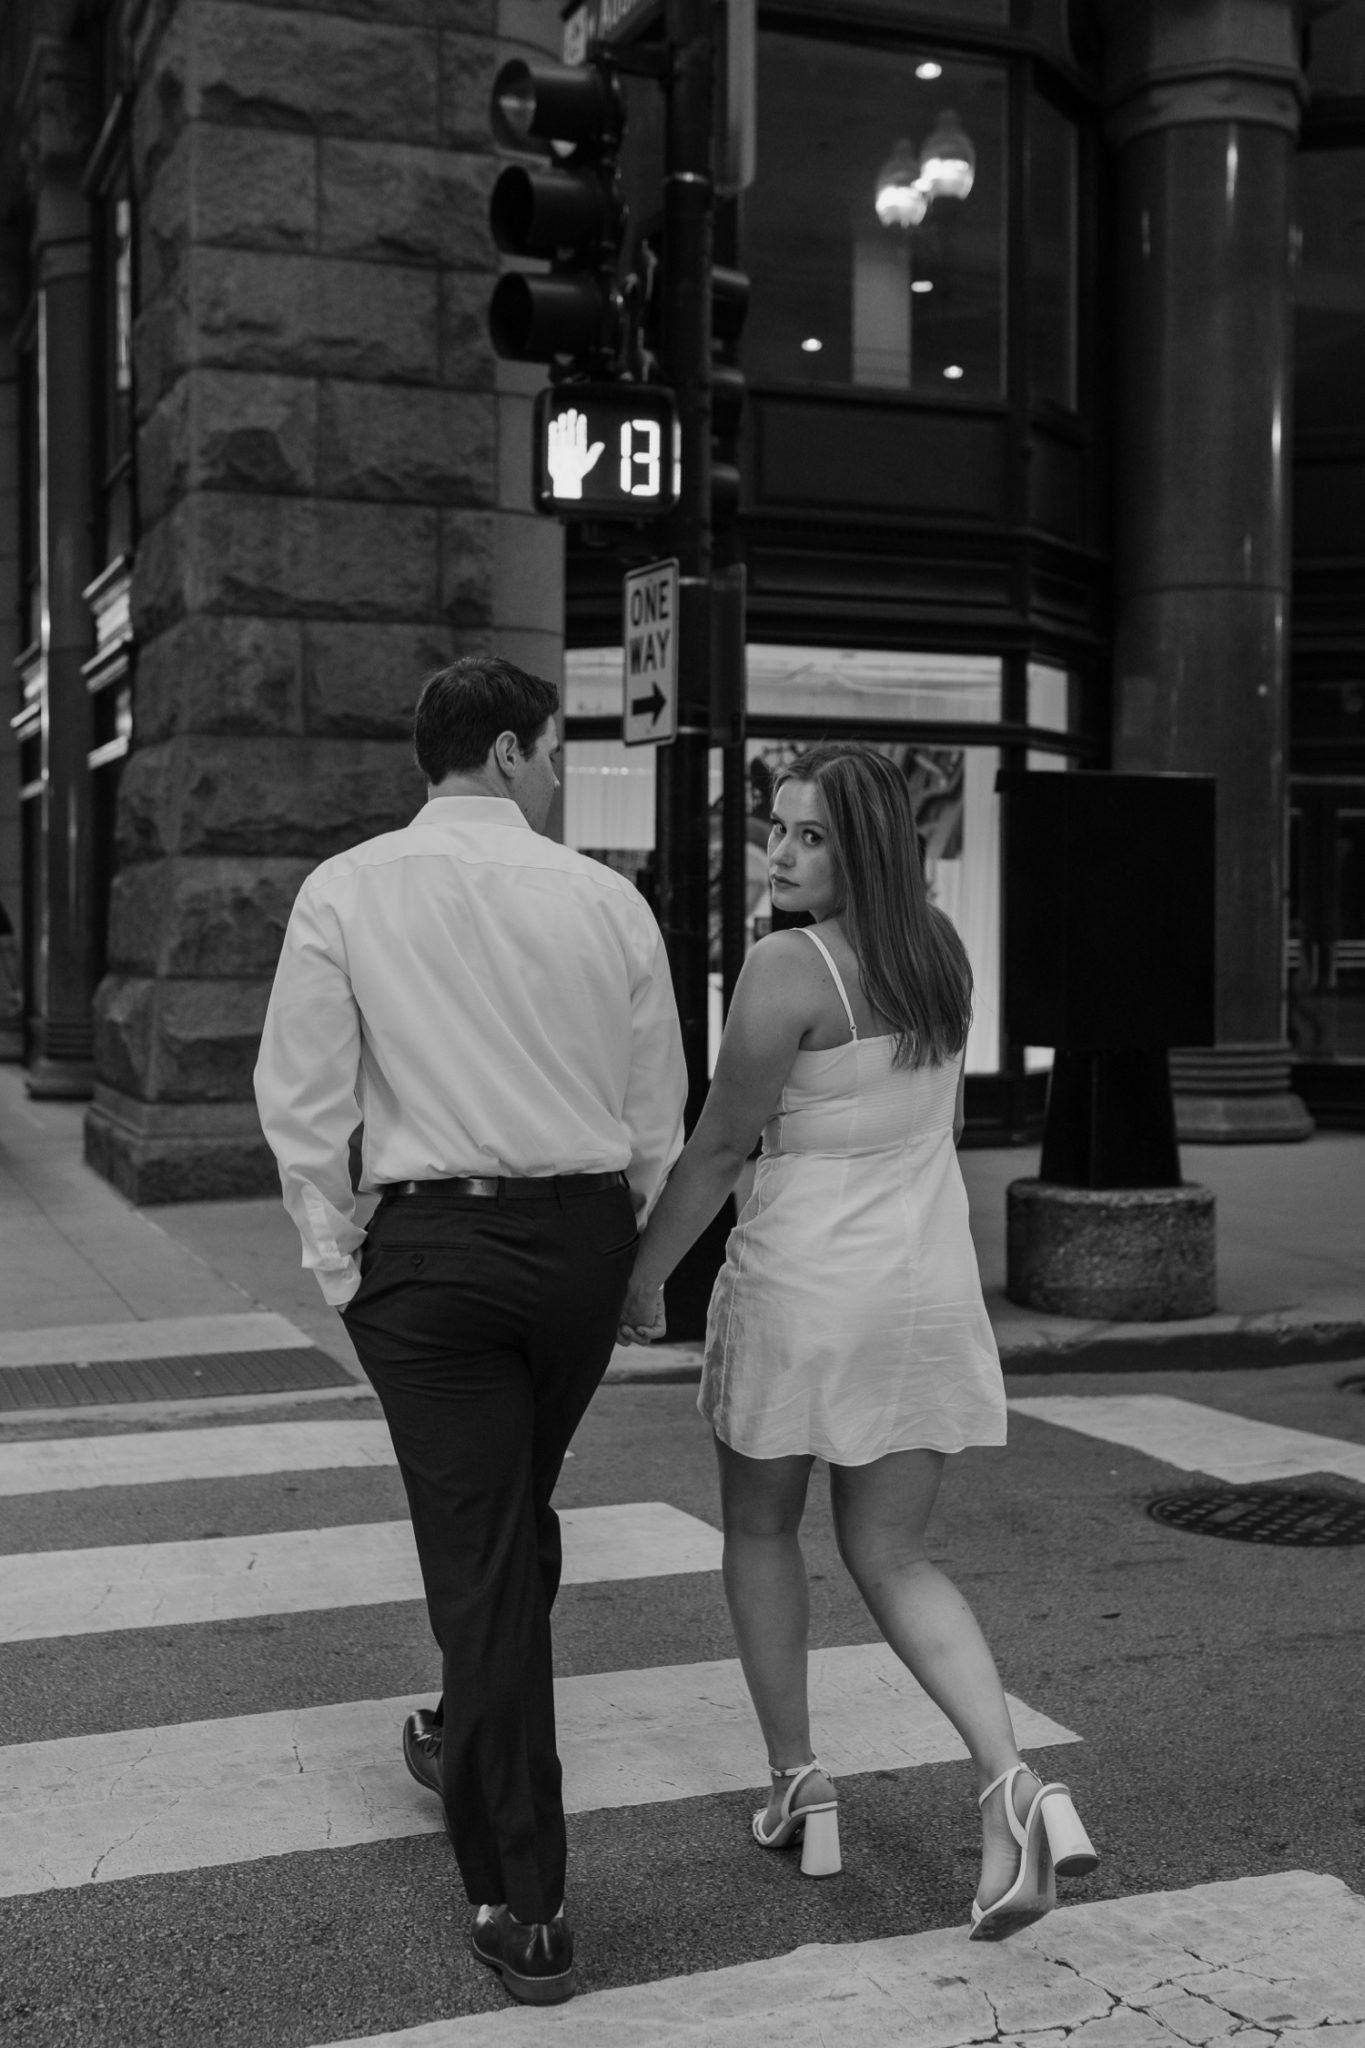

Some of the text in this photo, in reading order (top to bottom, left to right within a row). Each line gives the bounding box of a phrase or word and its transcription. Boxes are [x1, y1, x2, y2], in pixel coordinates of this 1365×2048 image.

[620, 419, 660, 496] 13
[630, 579, 669, 627] ONE
[630, 628, 670, 675] WAY
